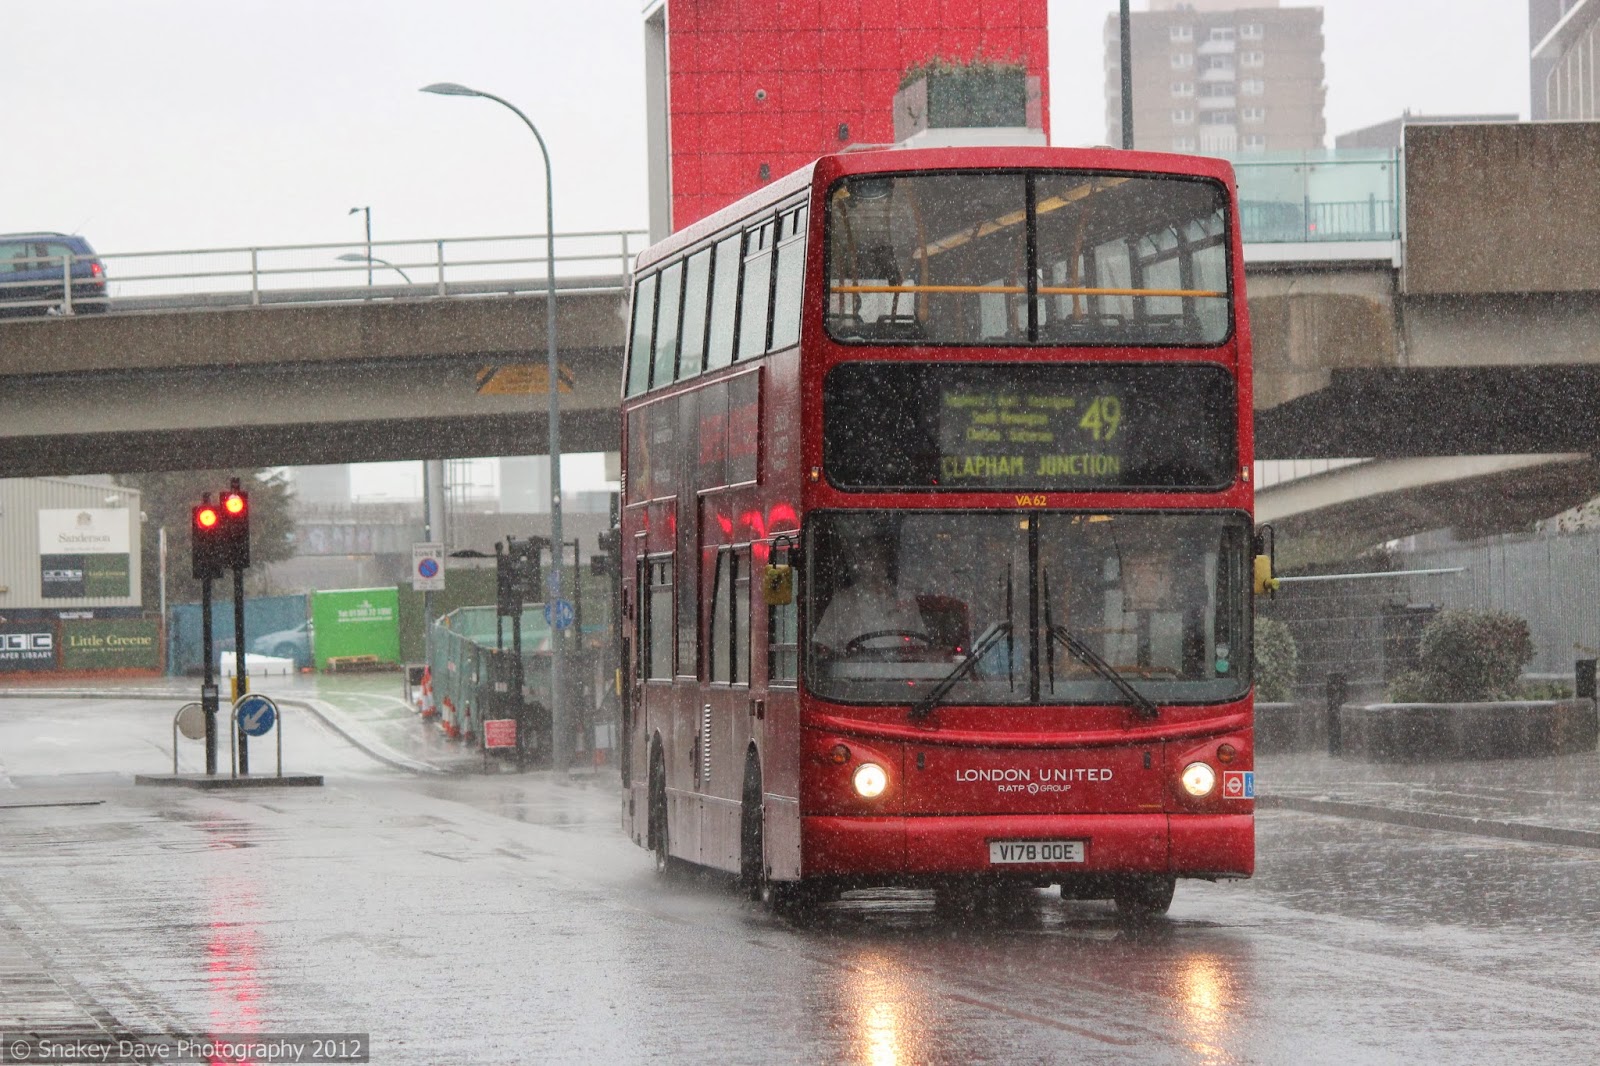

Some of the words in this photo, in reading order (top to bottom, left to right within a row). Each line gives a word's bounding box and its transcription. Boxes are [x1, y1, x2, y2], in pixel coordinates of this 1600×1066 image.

[1079, 396, 1121, 441] 49
[940, 454, 1024, 477] CLAPHAM
[1036, 453, 1121, 477] JUNCTION
[1015, 495, 1032, 506] VA
[1033, 495, 1047, 506] 62
[58, 532, 111, 544] Sanderson
[70, 635, 104, 647] Little
[106, 634, 152, 646] Greene
[22, 651, 52, 659] LIBRARY
[956, 769, 1031, 782] LONDON
[1039, 768, 1113, 782] UNITED
[998, 784, 1025, 792] RATP
[1040, 784, 1071, 792] GROUP
[1000, 844, 1037, 861] V178
